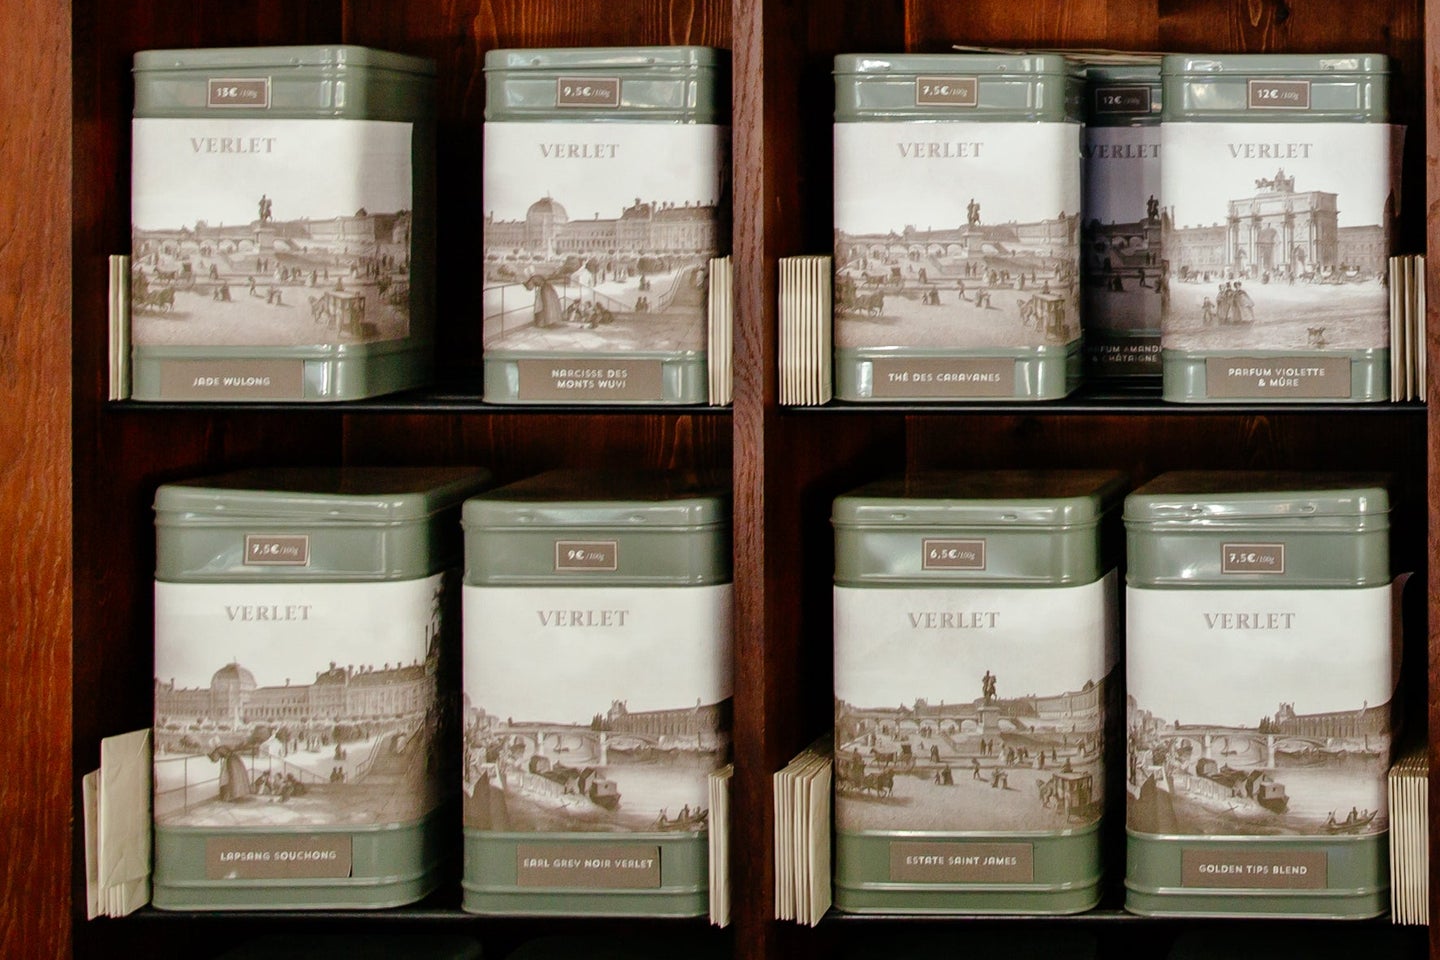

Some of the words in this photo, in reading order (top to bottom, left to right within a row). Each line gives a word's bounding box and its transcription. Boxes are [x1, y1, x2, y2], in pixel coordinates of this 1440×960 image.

[216, 87, 237, 97] 13€
[1257, 89, 1278, 98] 12€
[189, 138, 276, 153] VERLET
[897, 142, 984, 158] VERLET
[539, 144, 619, 158] VERLET
[1227, 144, 1313, 158] VERLET
[552, 369, 602, 377] NARCISSE
[888, 372, 908, 381] THÉ
[913, 373, 932, 381] DES
[937, 373, 1000, 381] CARAVANES
[1229, 368, 1271, 376] PARFUM
[1276, 368, 1324, 376] VIOLETTE
[193, 377, 219, 386] JADE
[224, 377, 270, 386] WULONG
[557, 380, 594, 388] MONTS
[1270, 377, 1298, 386] MÛRE
[568, 550, 584, 560] 9€
[225, 605, 312, 621] VERLET
[536, 610, 629, 626] VERLET
[907, 612, 1000, 628] VERLET
[1203, 613, 1295, 629] VERLET
[221, 852, 270, 861] LAPSANG
[275, 851, 336, 860] SOUCHONG
[907, 856, 944, 864] ESTATE
[949, 857, 979, 865] SAINT
[983, 857, 1016, 865] JAMES
[524, 859, 550, 867] EARL
[585, 860, 610, 868] NOIR
[615, 860, 653, 868] VERLET
[1199, 865, 1242, 873] GOLDEN
[1247, 865, 1268, 874] TIPS
[1273, 866, 1307, 874] BLEND
